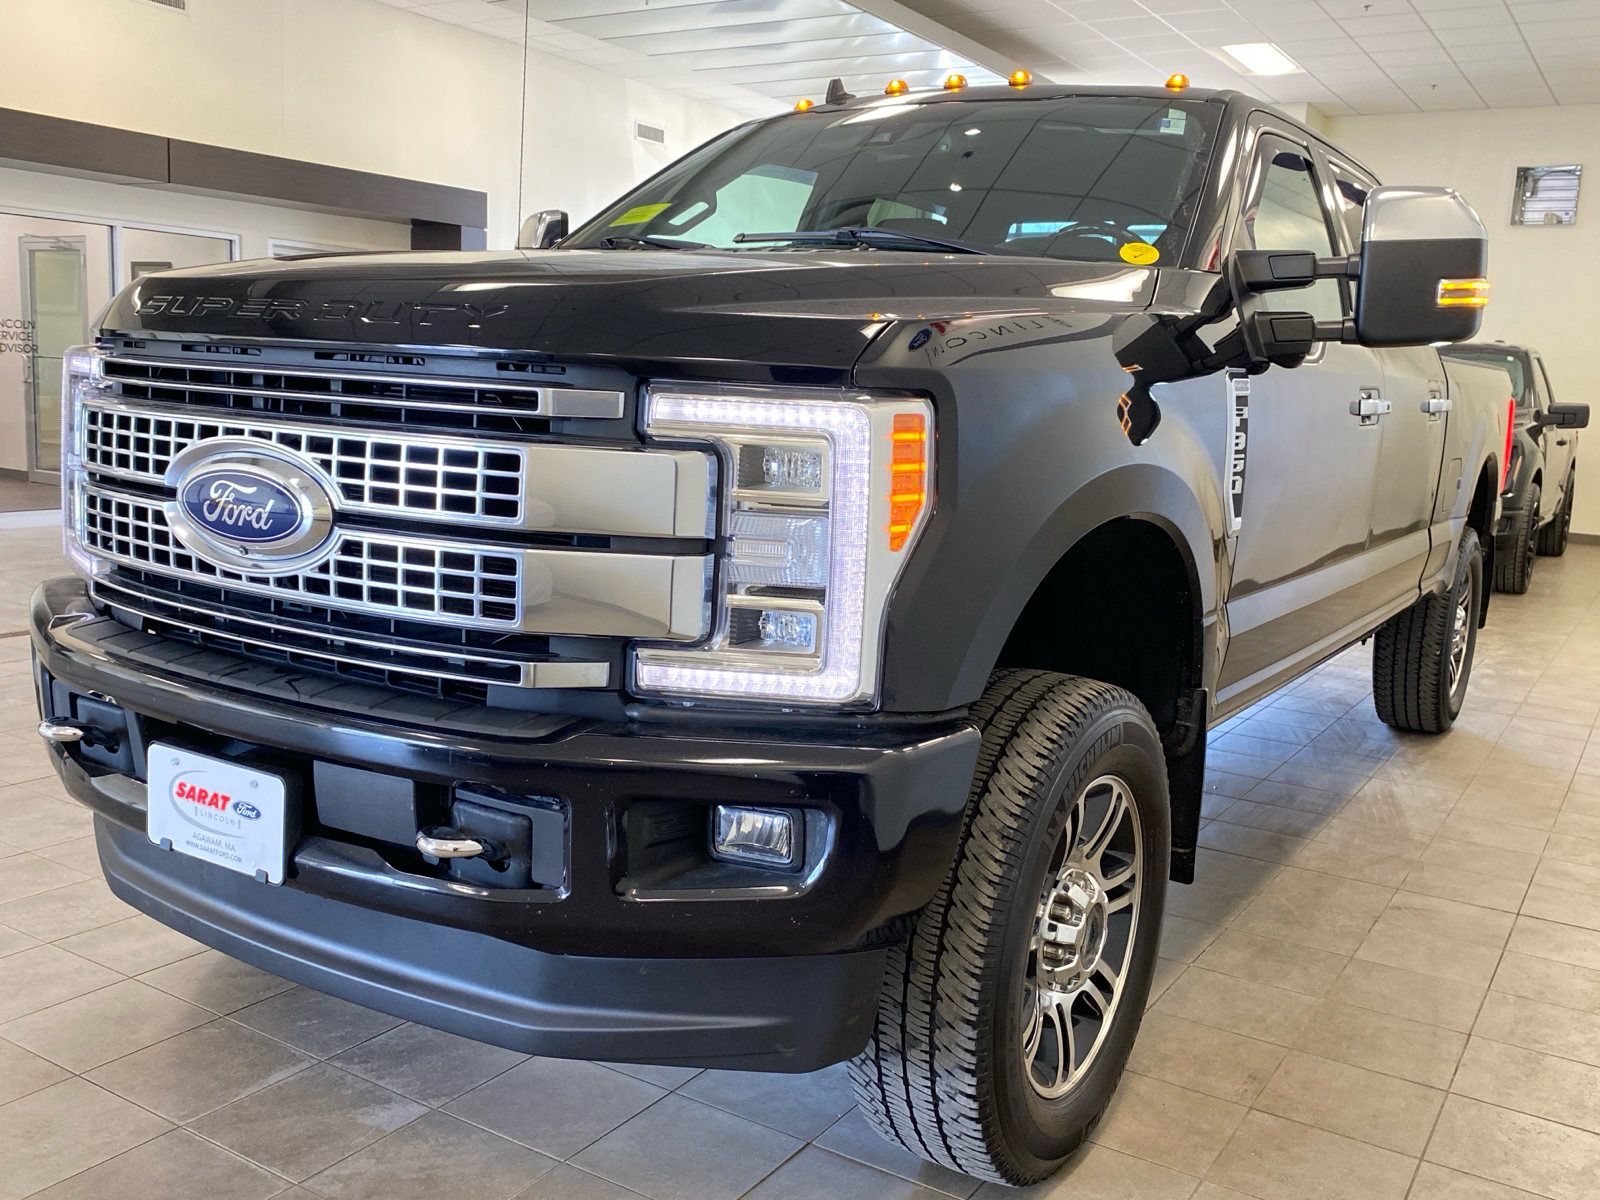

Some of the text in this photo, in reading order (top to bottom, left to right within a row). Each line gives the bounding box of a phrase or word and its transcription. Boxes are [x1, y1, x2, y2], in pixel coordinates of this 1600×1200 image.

[136, 295, 509, 328] SUPER DUTY
[203, 480, 275, 530] Ford
[1061, 723, 1121, 810] MICHELIN
[175, 781, 231, 811] SARAT
[236, 802, 257, 819] Ford
[200, 809, 236, 826] LINCOLN
[224, 841, 236, 852] MA
